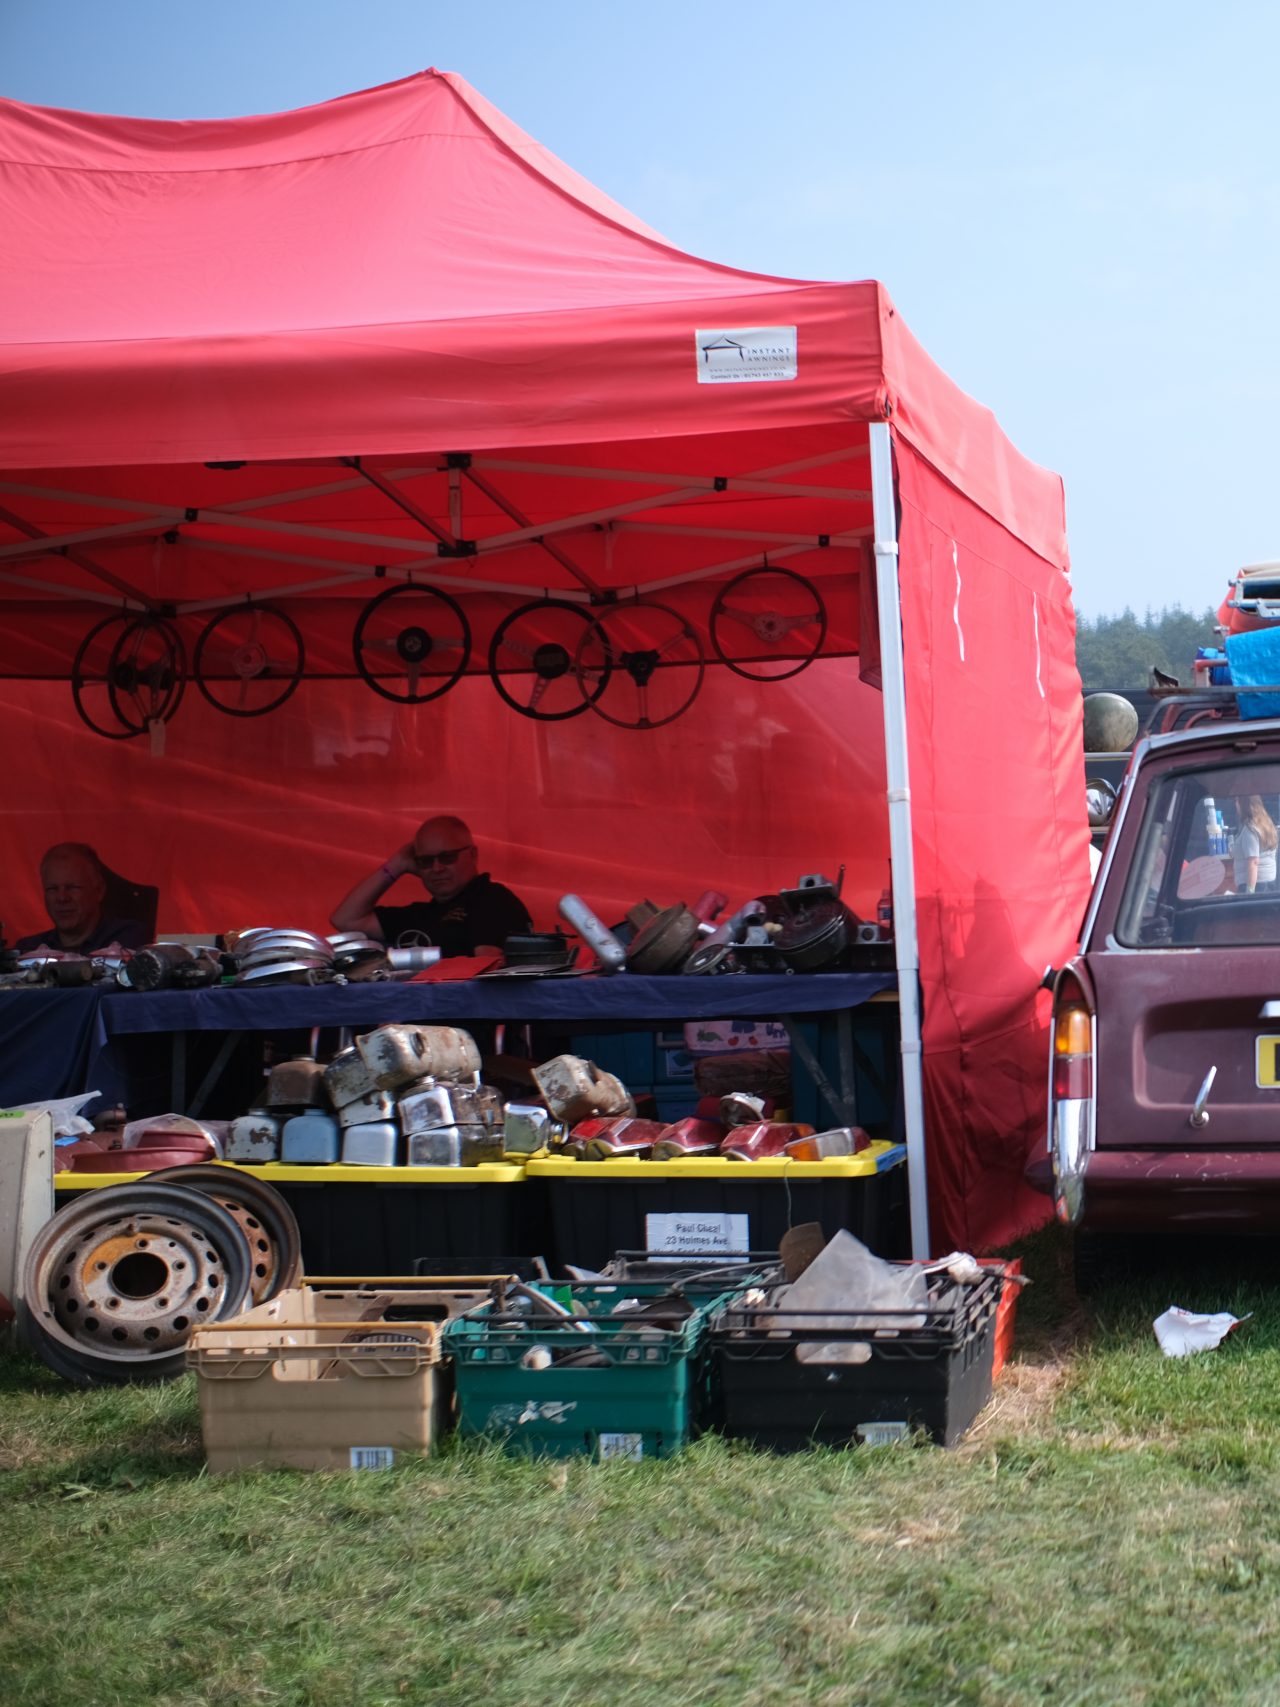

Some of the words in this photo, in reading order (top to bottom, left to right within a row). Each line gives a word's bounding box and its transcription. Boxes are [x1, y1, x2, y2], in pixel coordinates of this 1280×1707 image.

[747, 347, 790, 355] INSTANT
[675, 1223, 694, 1233] Paul
[666, 1236, 677, 1245] 23
[679, 1236, 710, 1245] Holmes
